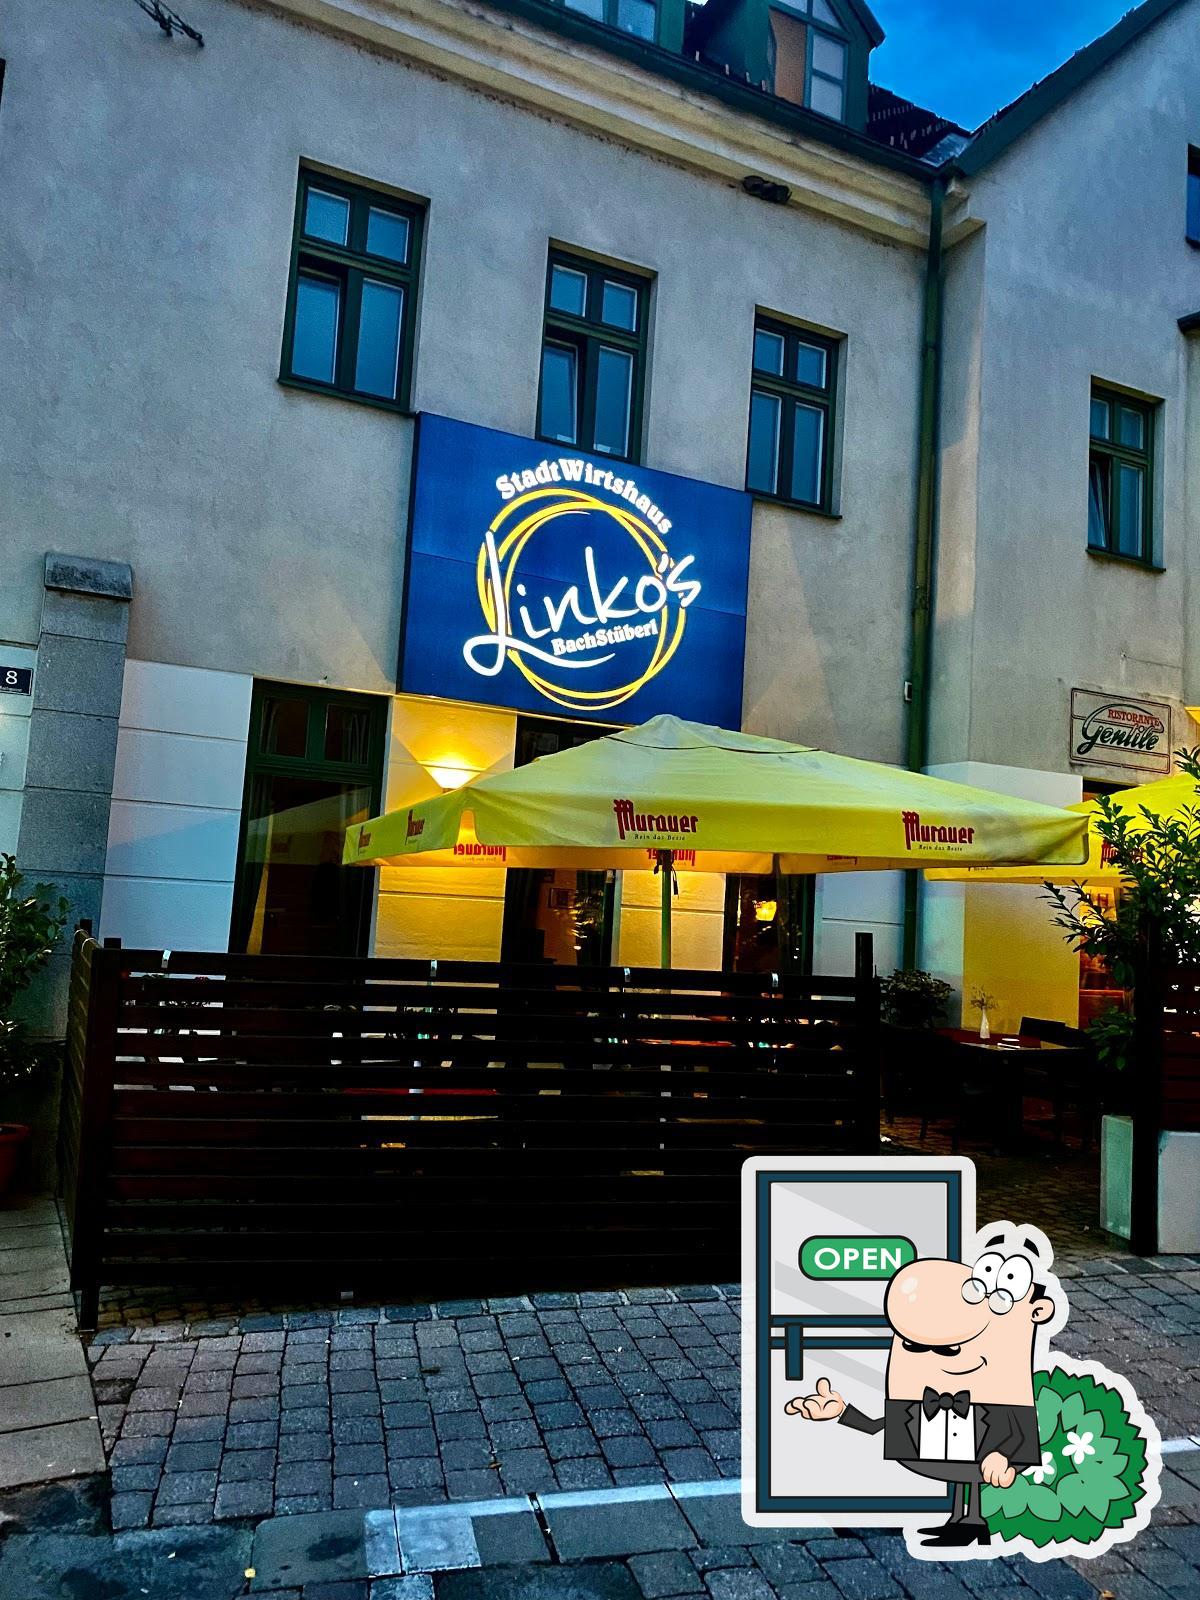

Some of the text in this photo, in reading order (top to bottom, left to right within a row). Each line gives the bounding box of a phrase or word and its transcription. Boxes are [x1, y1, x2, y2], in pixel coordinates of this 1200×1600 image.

[495, 458, 673, 535] StadtWirtshaus
[462, 530, 702, 677] Linko's
[550, 618, 660, 657] BachStüberl
[5, 671, 18, 685] 8
[1107, 708, 1161, 727] RISTORANTE
[613, 799, 699, 841] Murauer
[901, 811, 975, 851] Murauer
